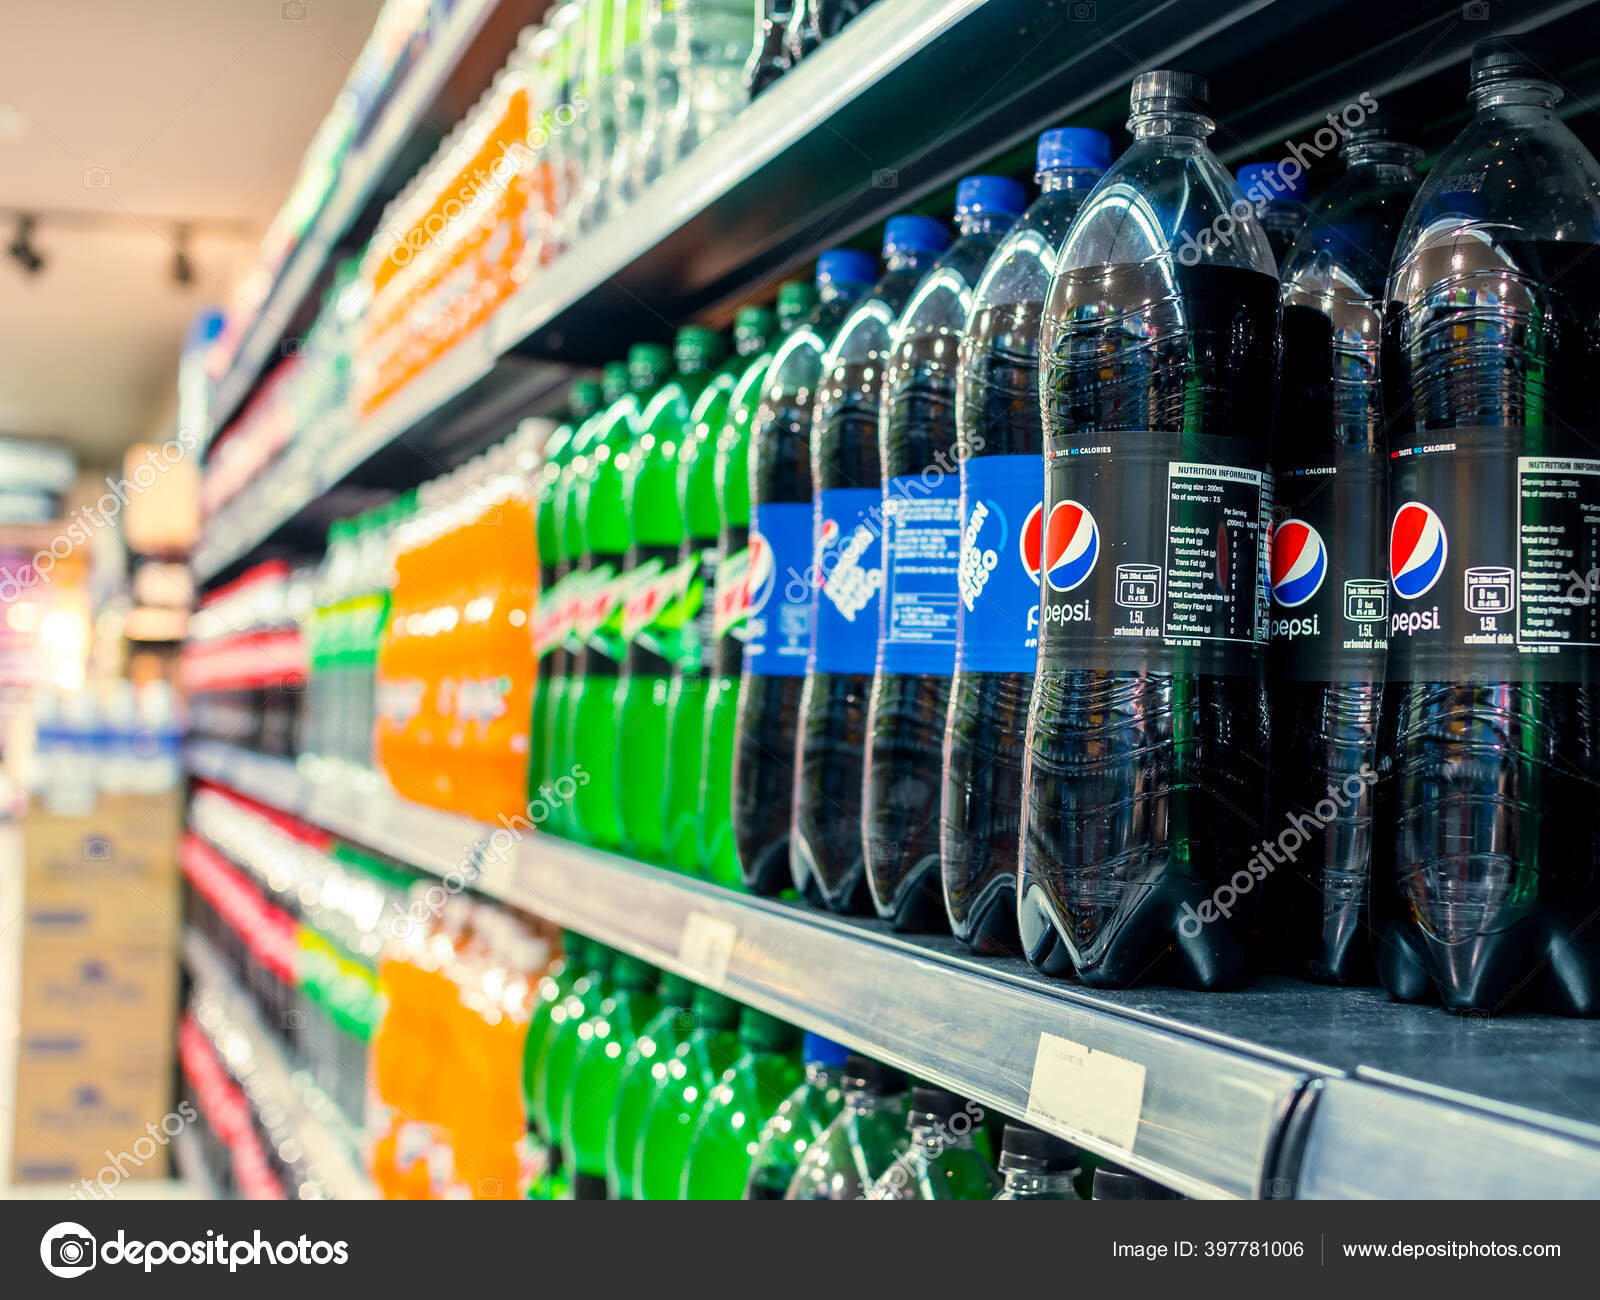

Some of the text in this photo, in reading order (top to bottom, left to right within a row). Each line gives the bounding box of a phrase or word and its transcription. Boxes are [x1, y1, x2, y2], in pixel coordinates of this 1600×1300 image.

[1080, 446, 1111, 454] CALORIES
[1423, 444, 1456, 452] CALORIES
[1528, 461, 1571, 470] NUTRITION
[1178, 466, 1257, 481] NUTRITION INFORMATION
[1172, 482, 1192, 491] Serving
[1187, 495, 1208, 503] servings
[1130, 584, 1134, 594] 0
[1183, 592, 1223, 601] Carbohydrates
[1129, 610, 1144, 624] 1.5L
[1391, 606, 1438, 637] pepsi
[1145, 626, 1159, 636] drink
[1271, 614, 1318, 640] pepsi
[1358, 624, 1373, 637] 1.5L
